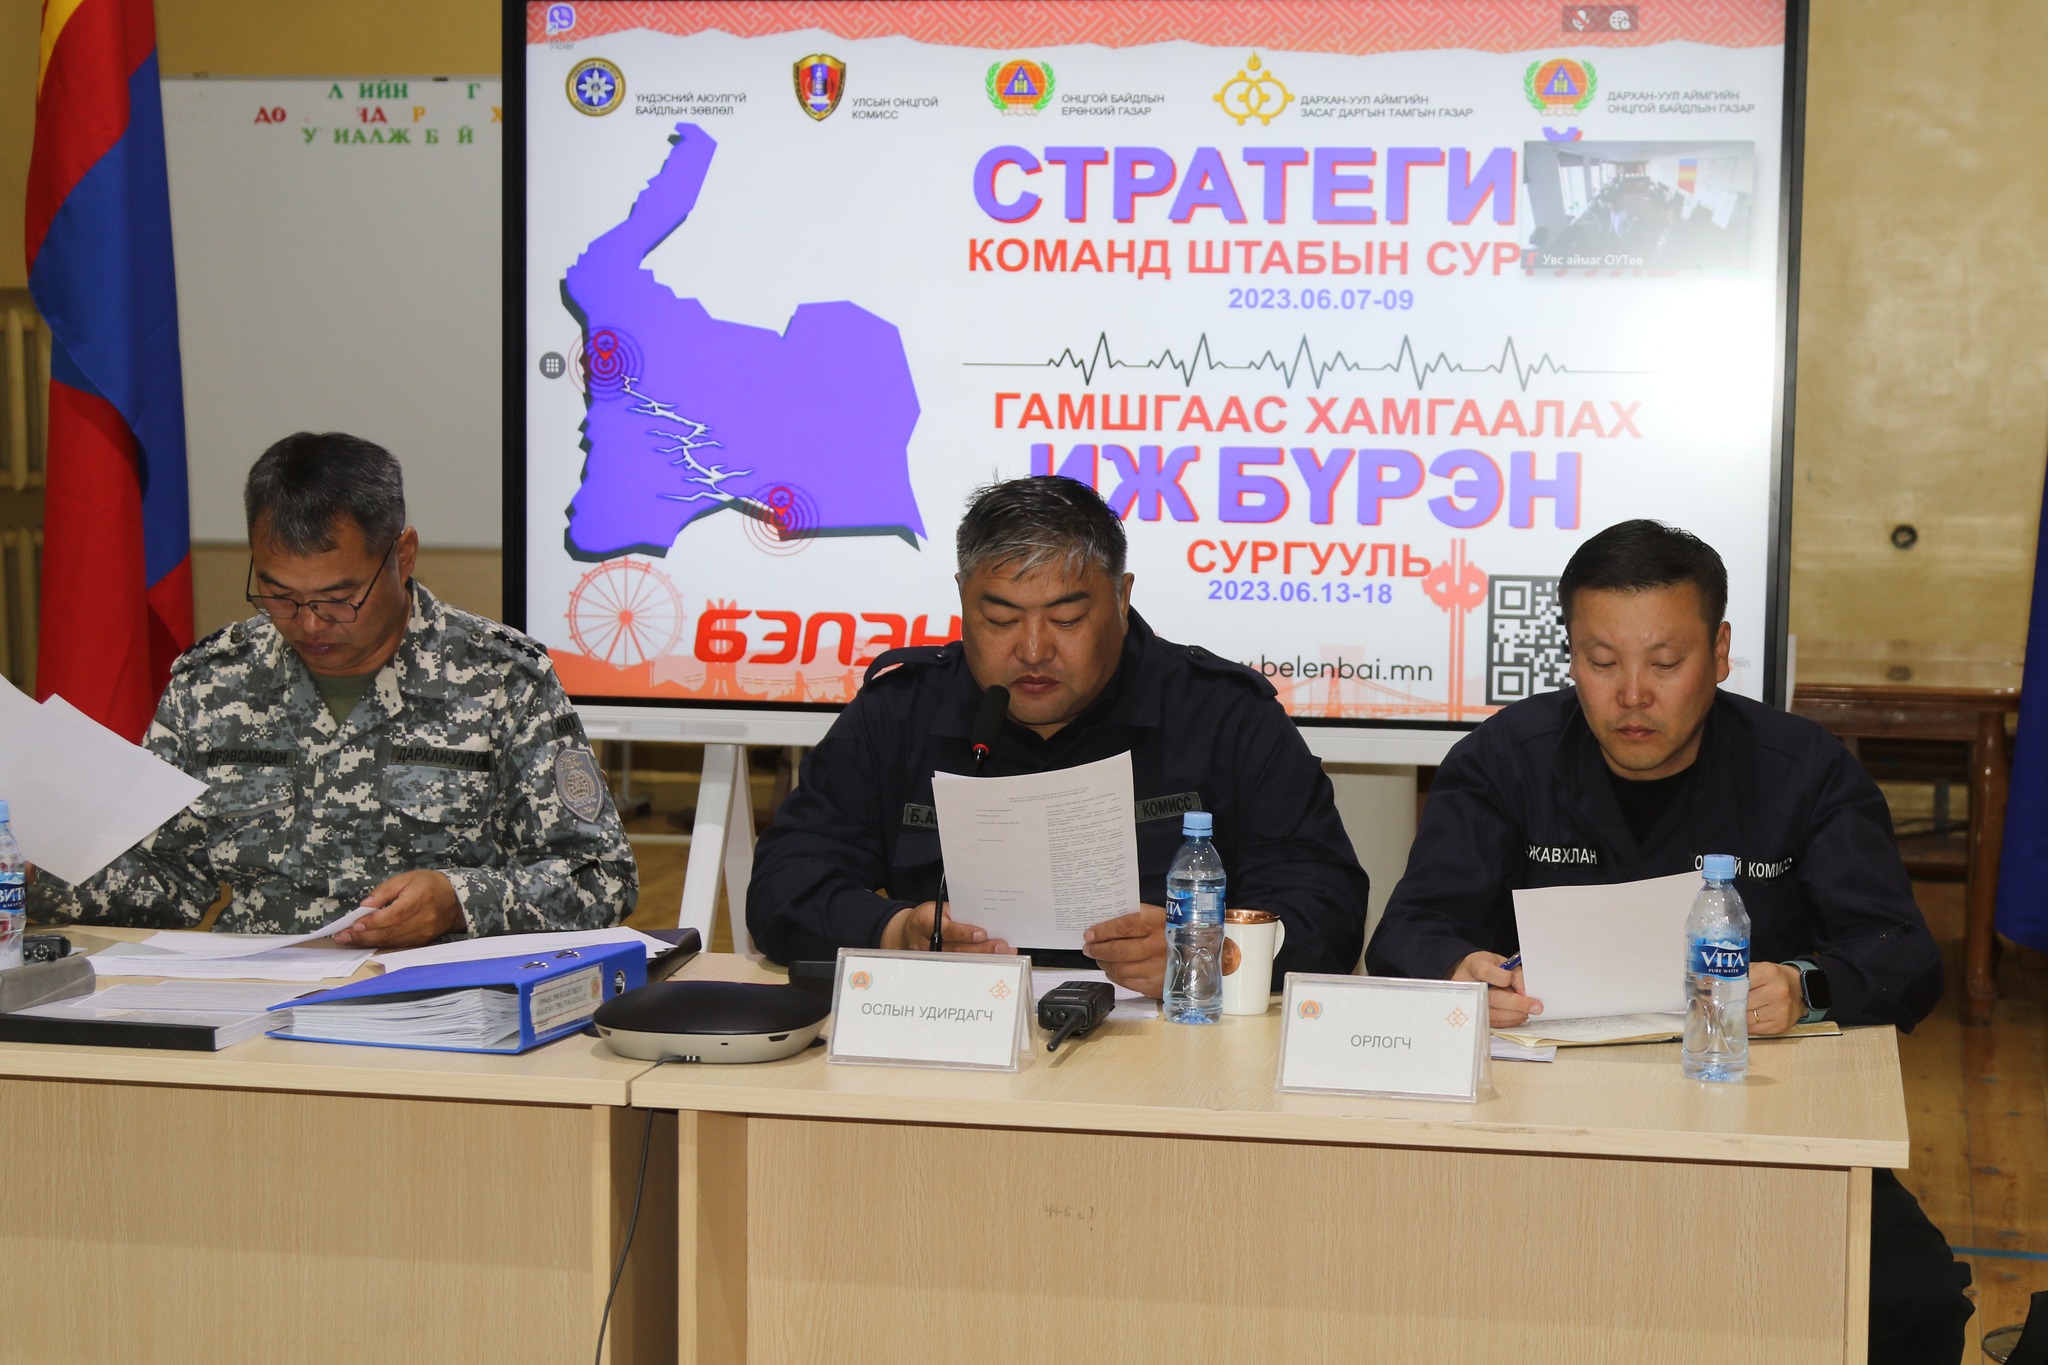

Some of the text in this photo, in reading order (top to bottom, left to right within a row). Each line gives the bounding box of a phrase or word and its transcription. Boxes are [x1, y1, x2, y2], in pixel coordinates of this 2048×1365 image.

[635, 92, 747, 104] ҮНДЭСНИЙ АЮУЛГҮЙ
[852, 96, 939, 109] УЛСЫН ОНЦГОЙ
[1061, 92, 1165, 106] ОНЦГОЙ БАЙДЛЫН
[1300, 94, 1429, 106] ДАРХАН-УУЛ АЙМГИЙН
[1606, 89, 1740, 102] ДАРХАН-УУЛ АЙМГИЙН
[635, 105, 734, 116] БАЙДЛЫН ЗӨВЛӨЛ
[852, 110, 898, 120] КОМИСС
[1061, 105, 1152, 116] ЕРӨНХИЙ ГАЗАР
[1300, 107, 1474, 119] ЗАСАГ ДАРГЫН ТАМГЫН ГАЗАР
[1607, 102, 1756, 115] ОНЦГОЙ БАЙДЛЫН ГАЗАР
[972, 126, 1584, 226] СТРАТЕГИ
[968, 236, 1172, 281] КОМАНД
[1188, 238, 1410, 277] ШТАБЫН
[1542, 254, 1563, 266] Увс
[1566, 253, 1601, 266] аймаг
[1228, 286, 1415, 312] 2023.06.07-09
[994, 392, 1644, 439] ГАМШГААС ХАМГААЛАХ
[1217, 445, 1582, 530] БҮРЭН
[1186, 538, 1434, 579] СУРГУУЛЬ
[1207, 579, 1393, 605] 2023.06.13-18
[1142, 795, 1193, 818] КОМИСС
[1700, 947, 1746, 969] VITA
[861, 1002, 994, 1023] ОСЛЫН УДИРДАГЧ
[1350, 1034, 1412, 1050] ОРЛОГЧ
